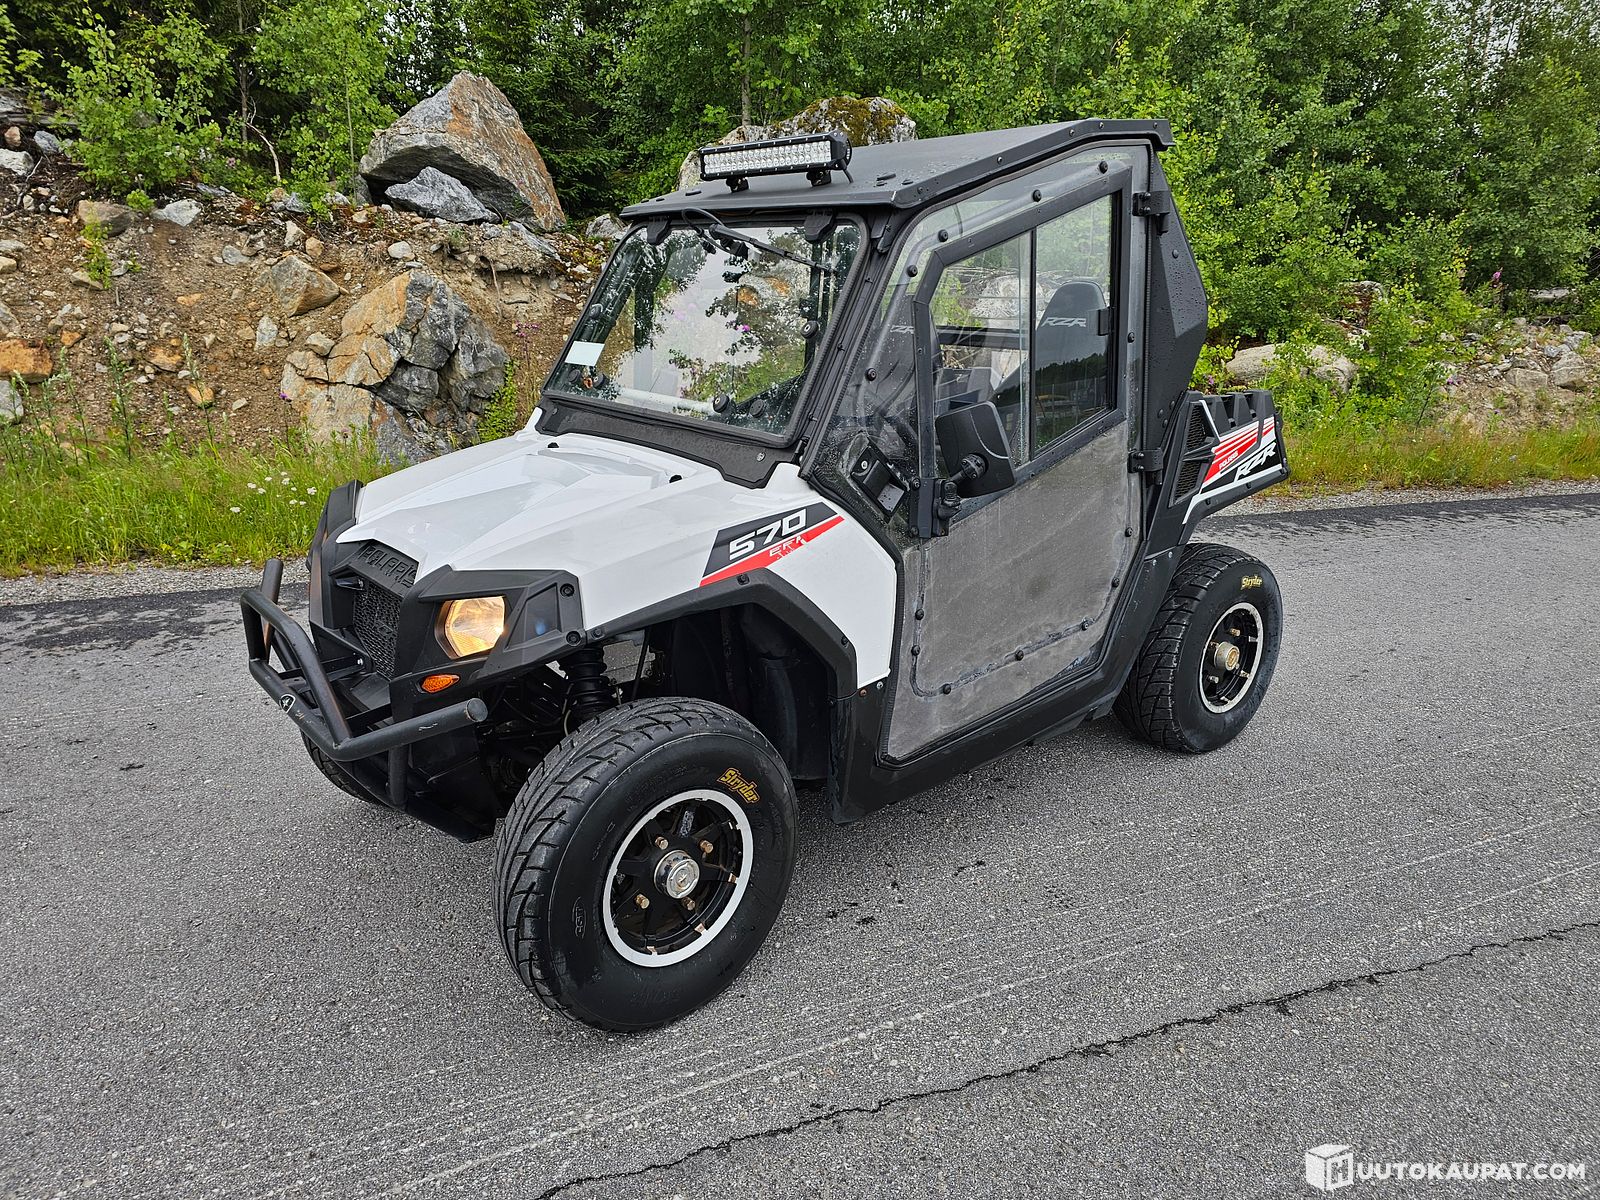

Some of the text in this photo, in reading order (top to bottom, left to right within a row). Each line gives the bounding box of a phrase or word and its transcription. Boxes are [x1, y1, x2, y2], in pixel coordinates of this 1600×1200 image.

[890, 325, 915, 335] ZR
[1041, 317, 1087, 327] RZR
[1234, 442, 1277, 482] RZR
[729, 509, 806, 560] 570
[718, 768, 760, 803] Stryder
